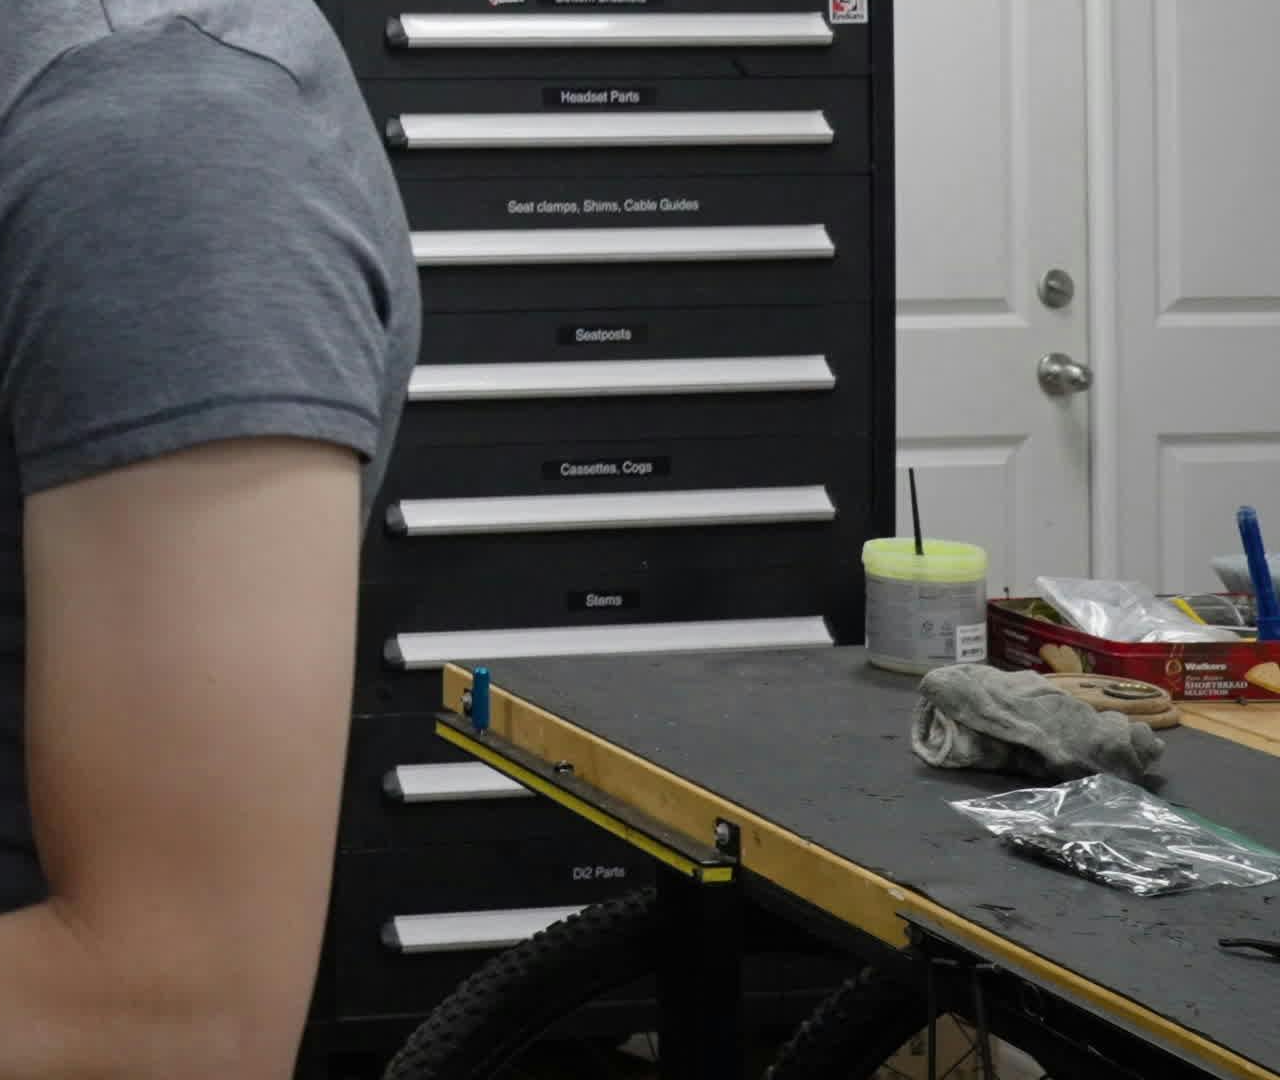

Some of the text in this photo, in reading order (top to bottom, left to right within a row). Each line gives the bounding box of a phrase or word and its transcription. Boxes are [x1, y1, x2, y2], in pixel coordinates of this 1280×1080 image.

[560, 89, 640, 105] Headset Parts
[507, 199, 534, 215] Seat
[624, 198, 657, 213] Cable
[658, 198, 700, 213] Guides
[575, 327, 632, 344] Seatposts
[622, 460, 653, 476] Cogs
[586, 592, 622, 607] Stems
[572, 865, 625, 881] Di2 Parts
